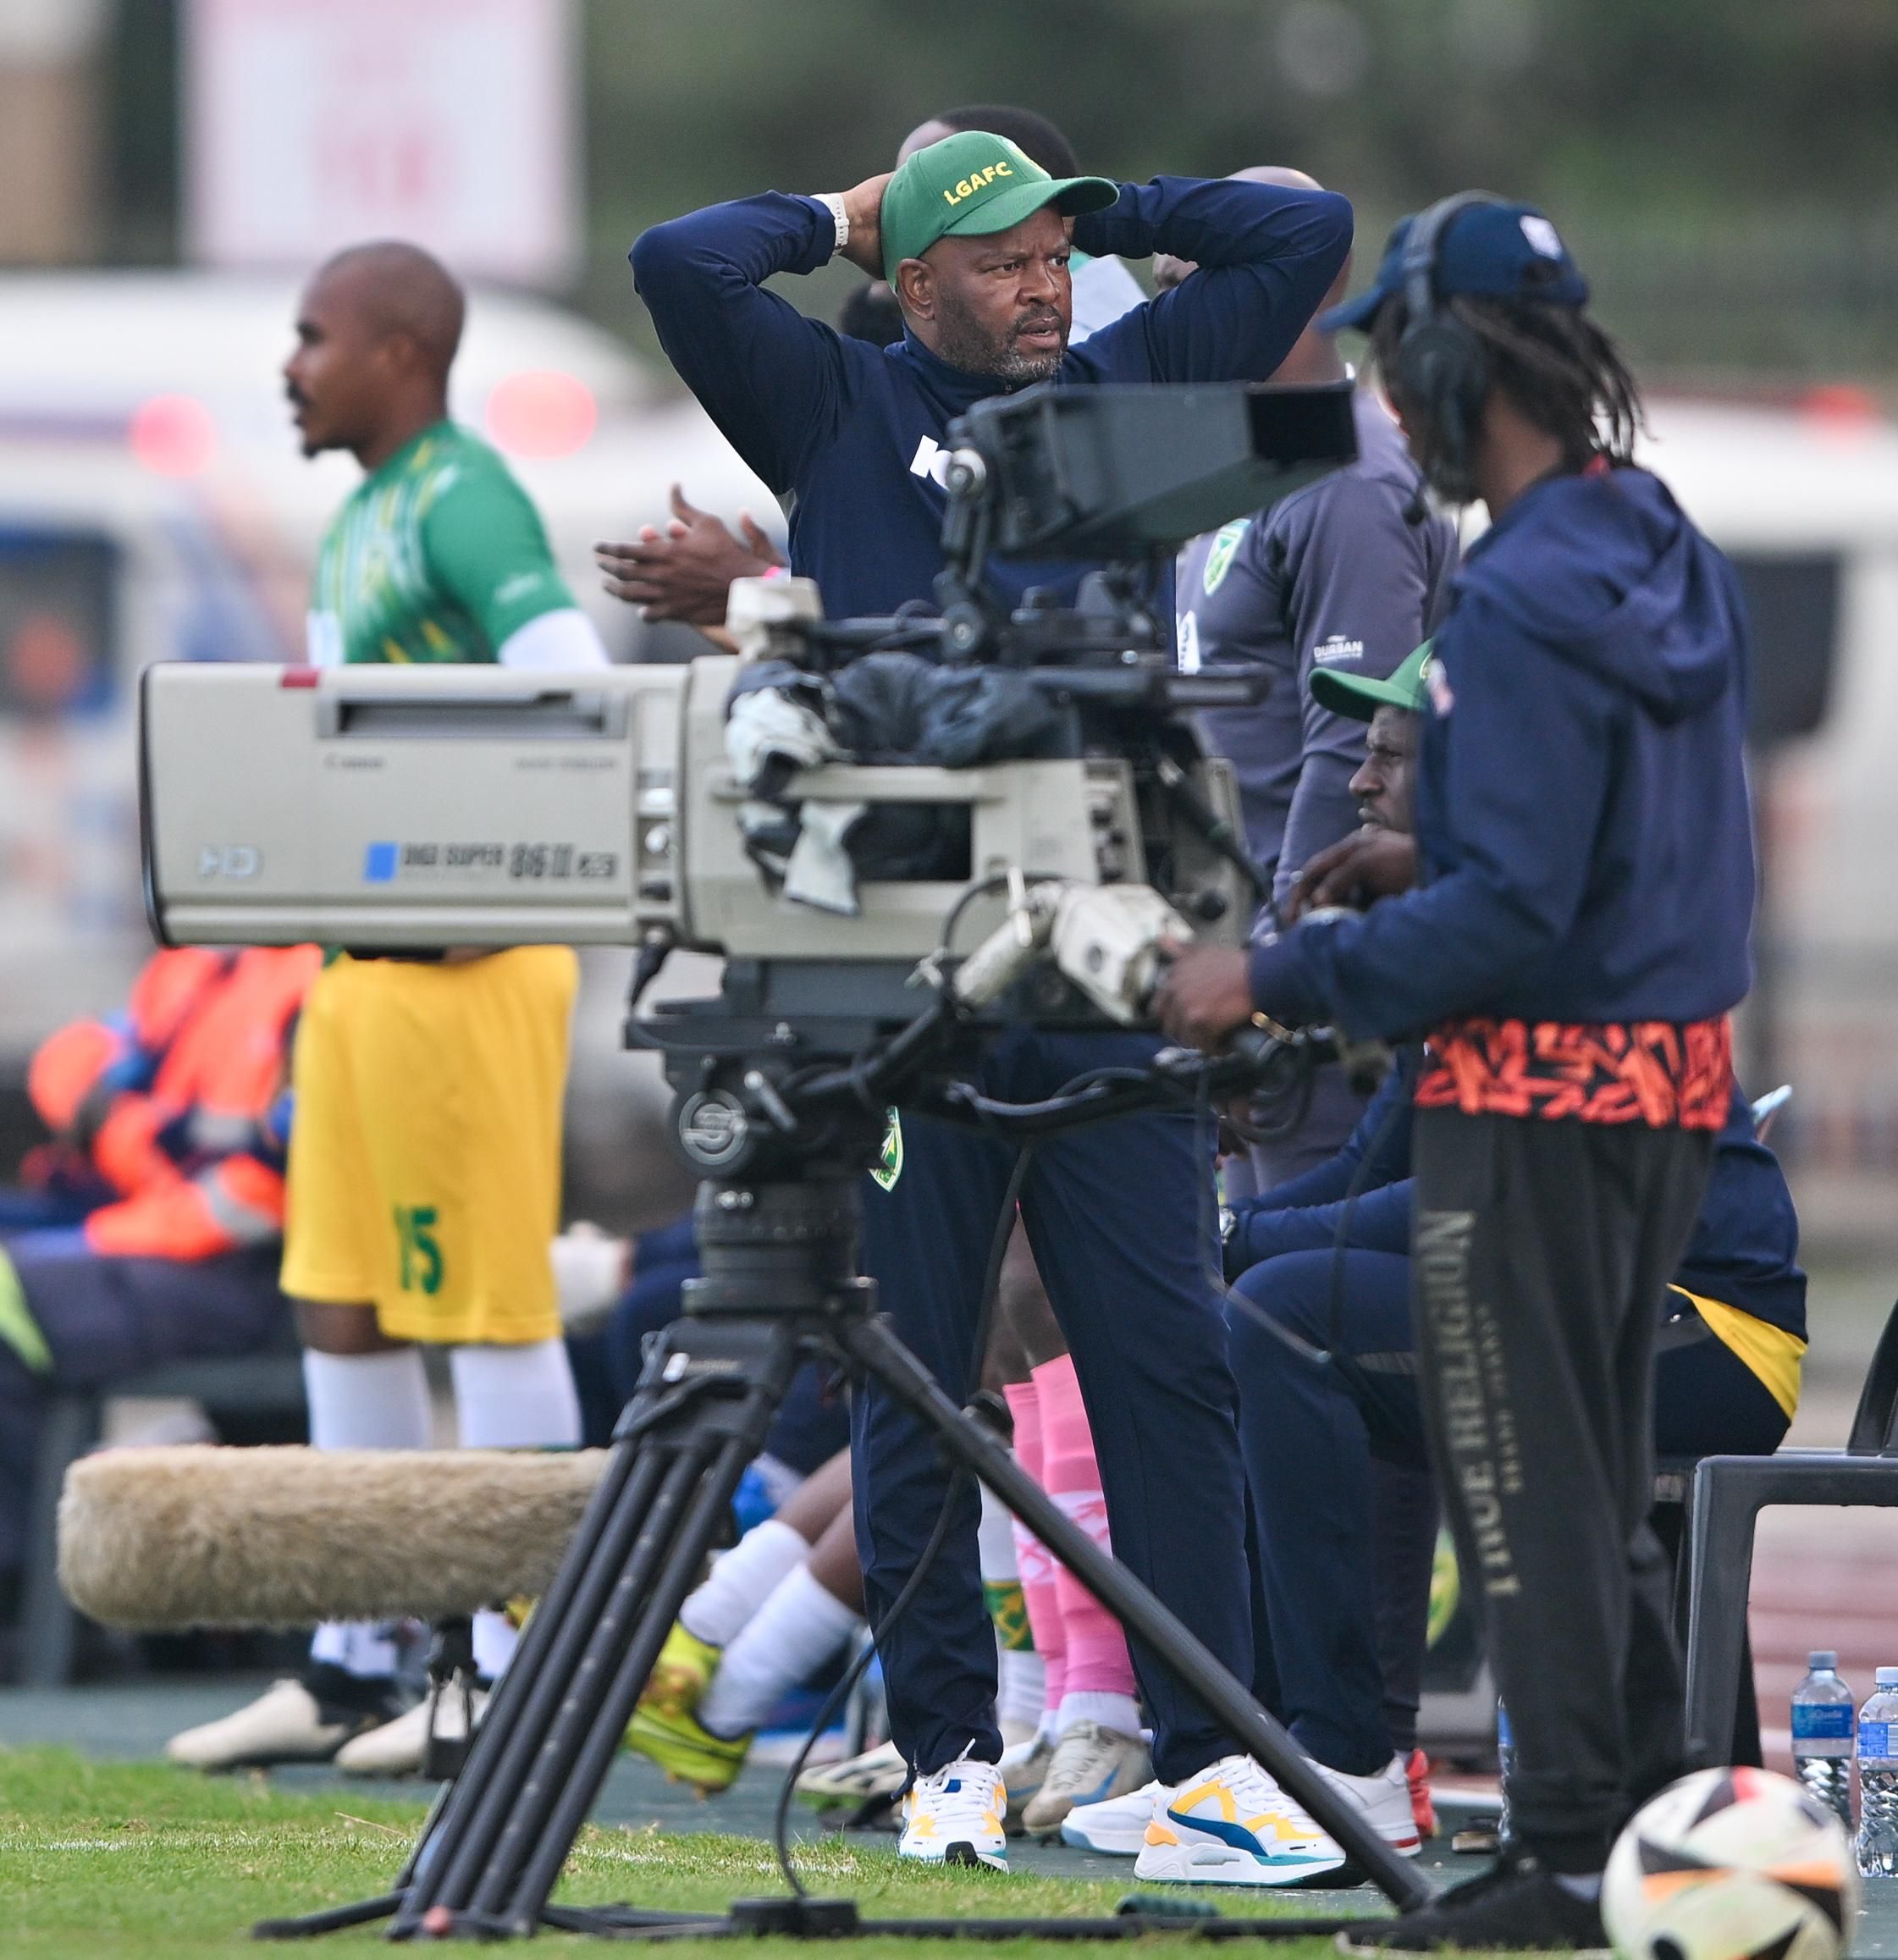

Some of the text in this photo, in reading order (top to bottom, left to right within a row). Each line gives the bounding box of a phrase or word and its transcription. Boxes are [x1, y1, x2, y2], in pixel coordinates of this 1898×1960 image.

[943, 161, 1013, 207] LGAFC
[1313, 640, 1364, 658] DURBAN
[392, 1202, 444, 1295] 15
